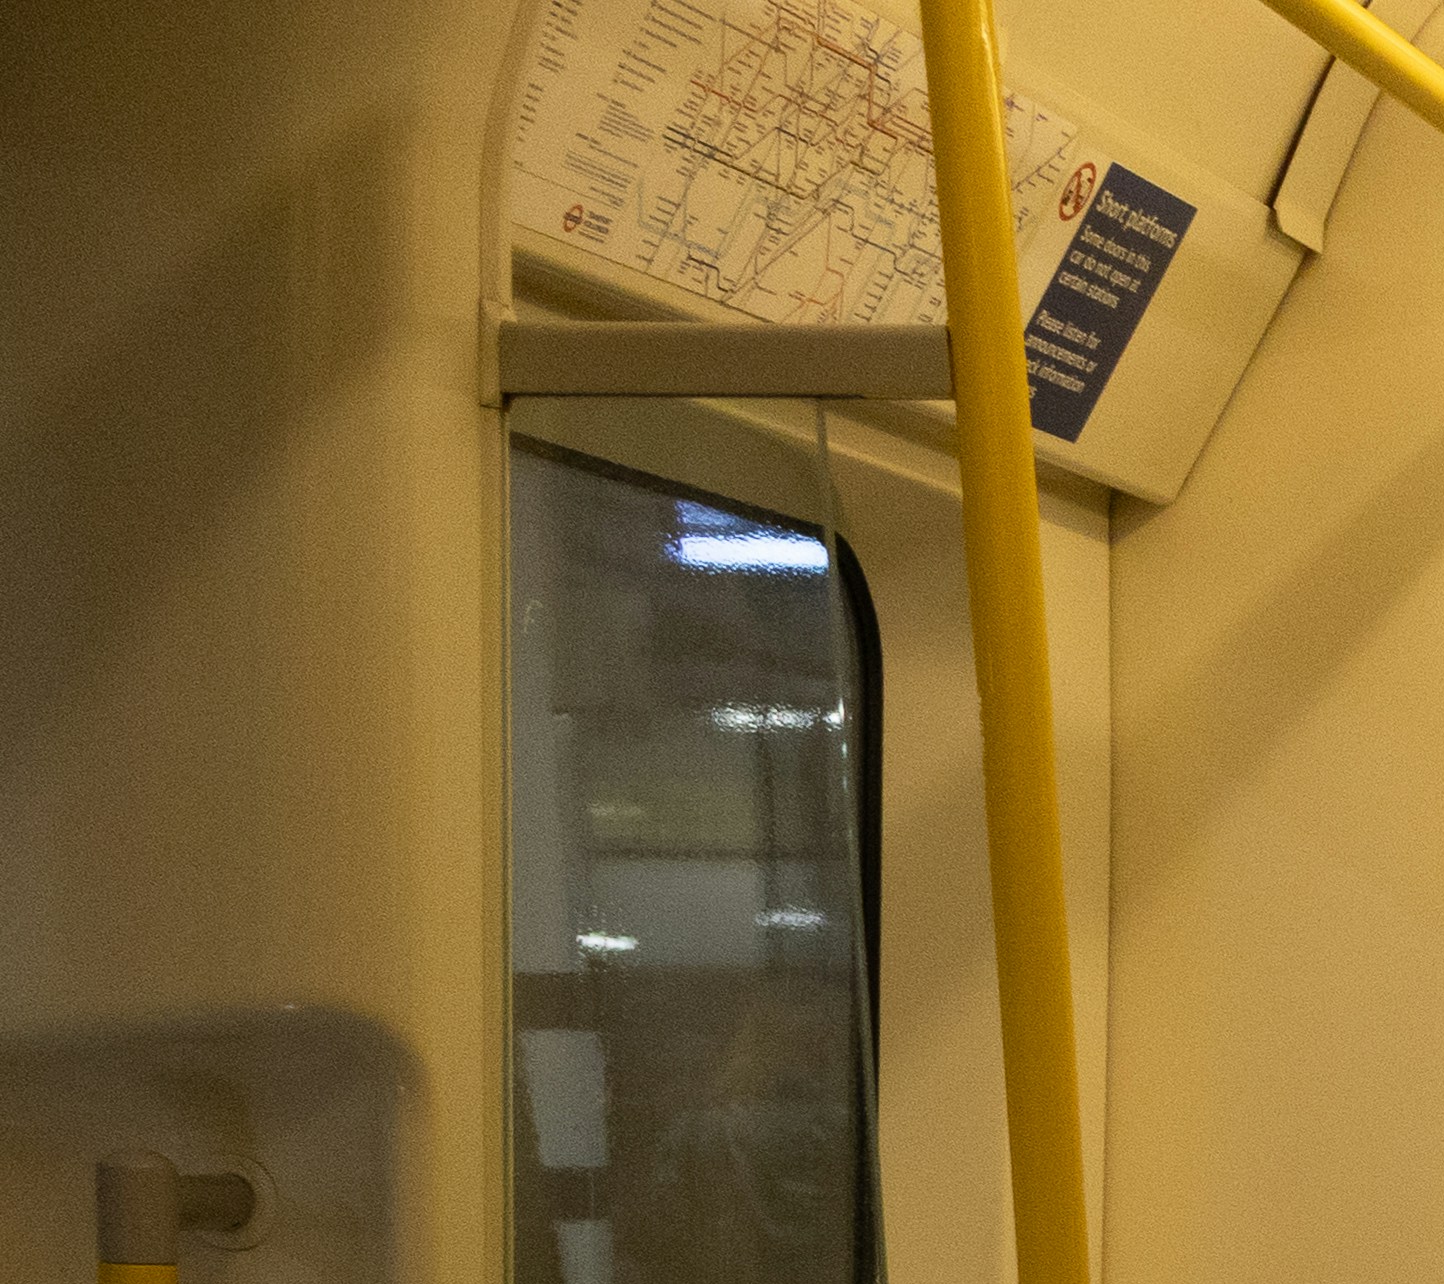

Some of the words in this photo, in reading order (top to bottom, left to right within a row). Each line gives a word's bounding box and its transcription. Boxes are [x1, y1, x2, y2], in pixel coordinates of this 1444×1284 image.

[1081, 224, 1105, 249] Some
[1104, 237, 1127, 260] doors
[1096, 190, 1129, 224] Short
[1122, 209, 1178, 249] platforms
